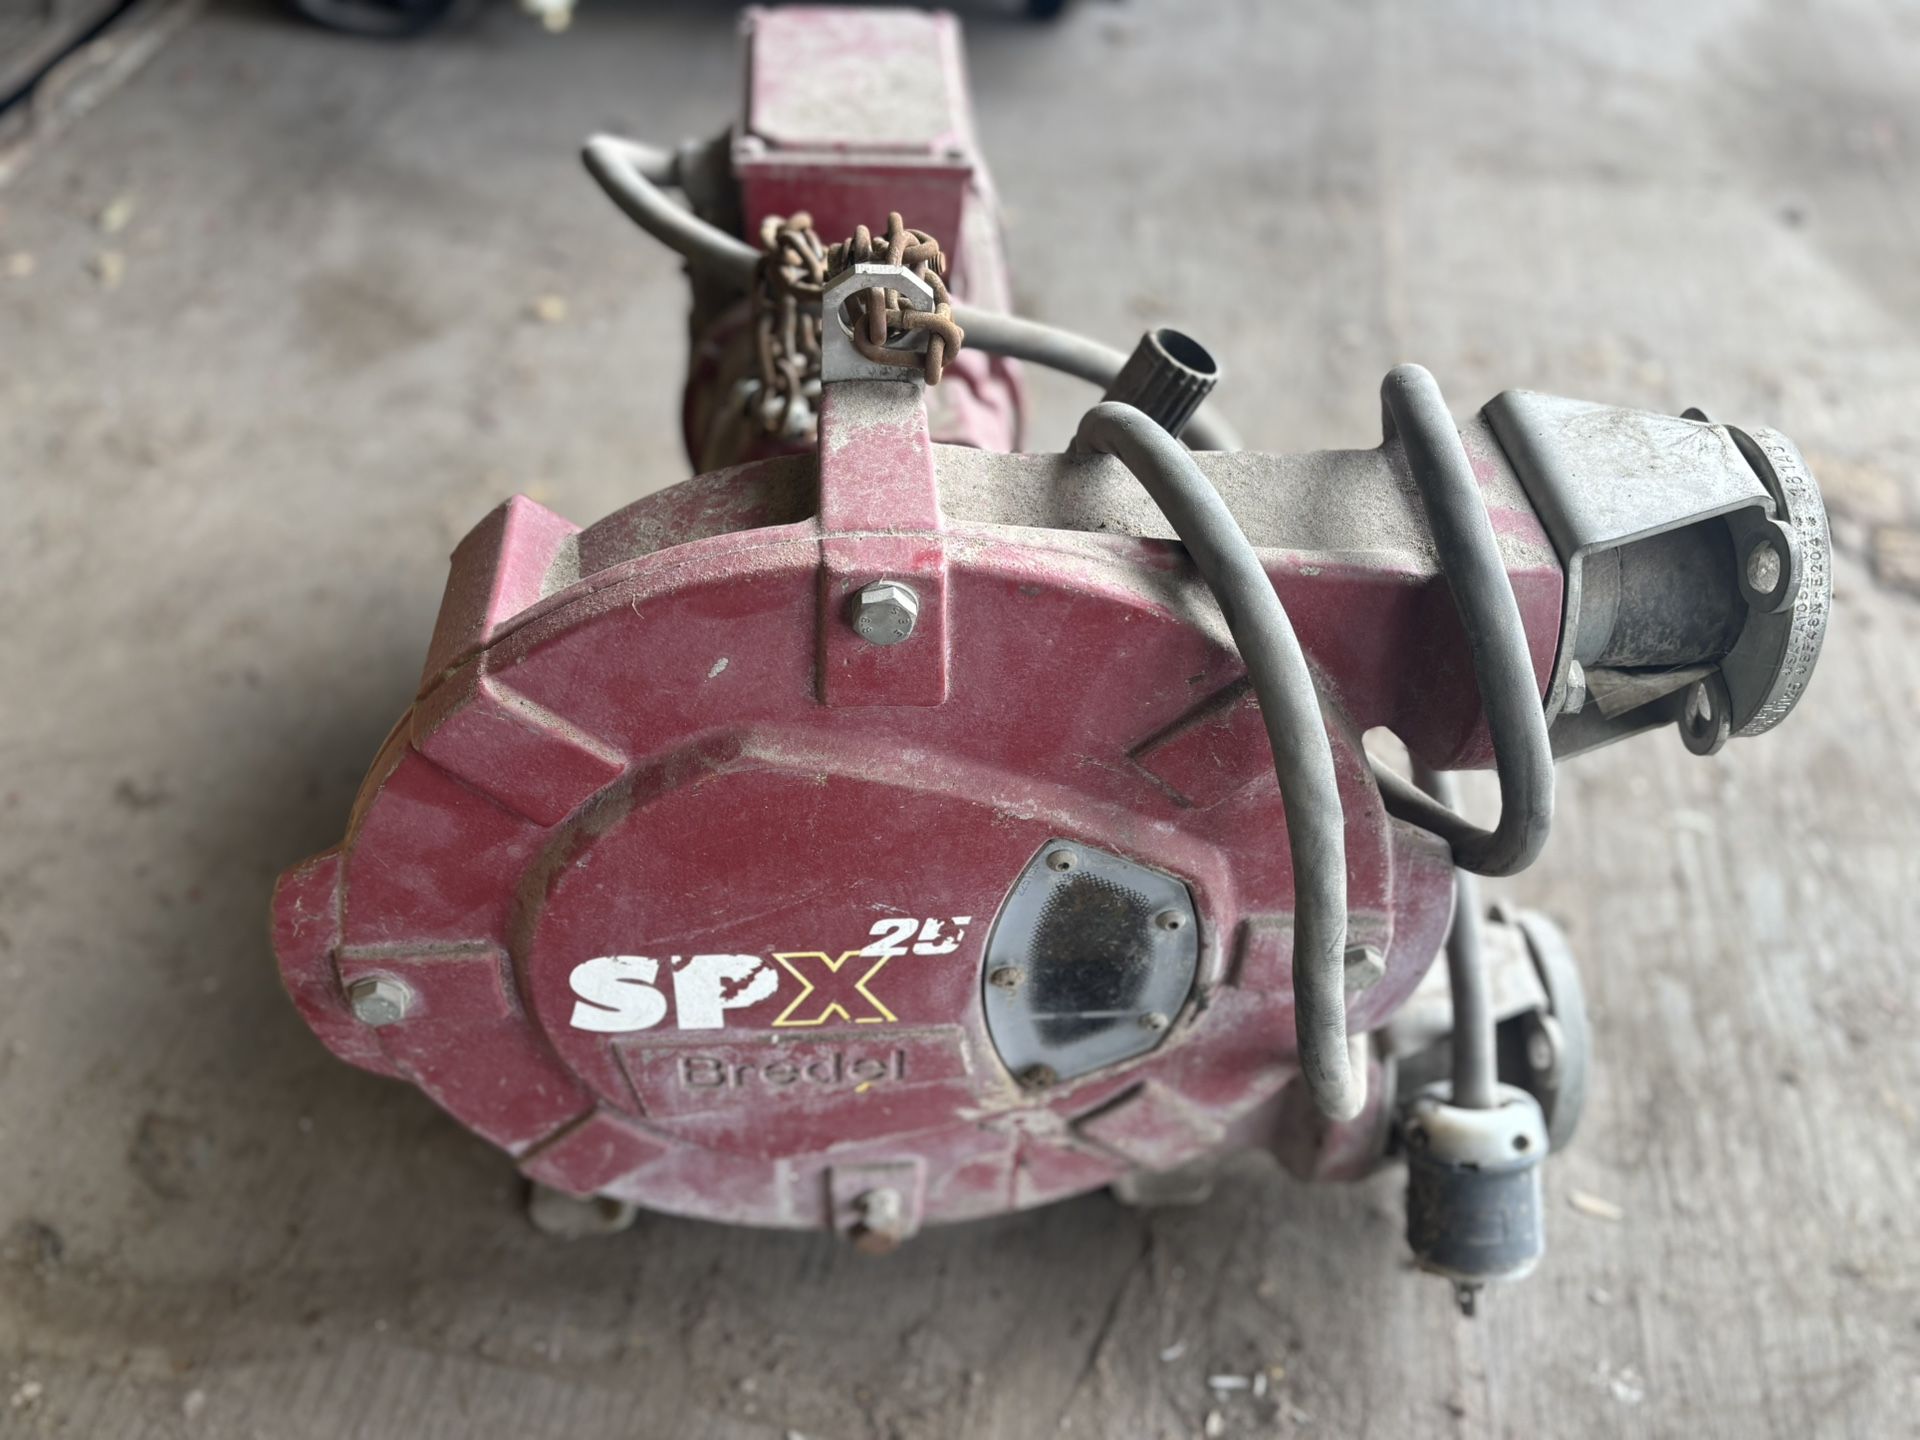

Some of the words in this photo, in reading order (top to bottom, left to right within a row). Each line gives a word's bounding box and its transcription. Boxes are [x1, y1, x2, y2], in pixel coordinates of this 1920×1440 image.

[568, 950, 898, 1033] SPX
[859, 916, 972, 958] 25
[679, 1050, 908, 1090] Bredel
